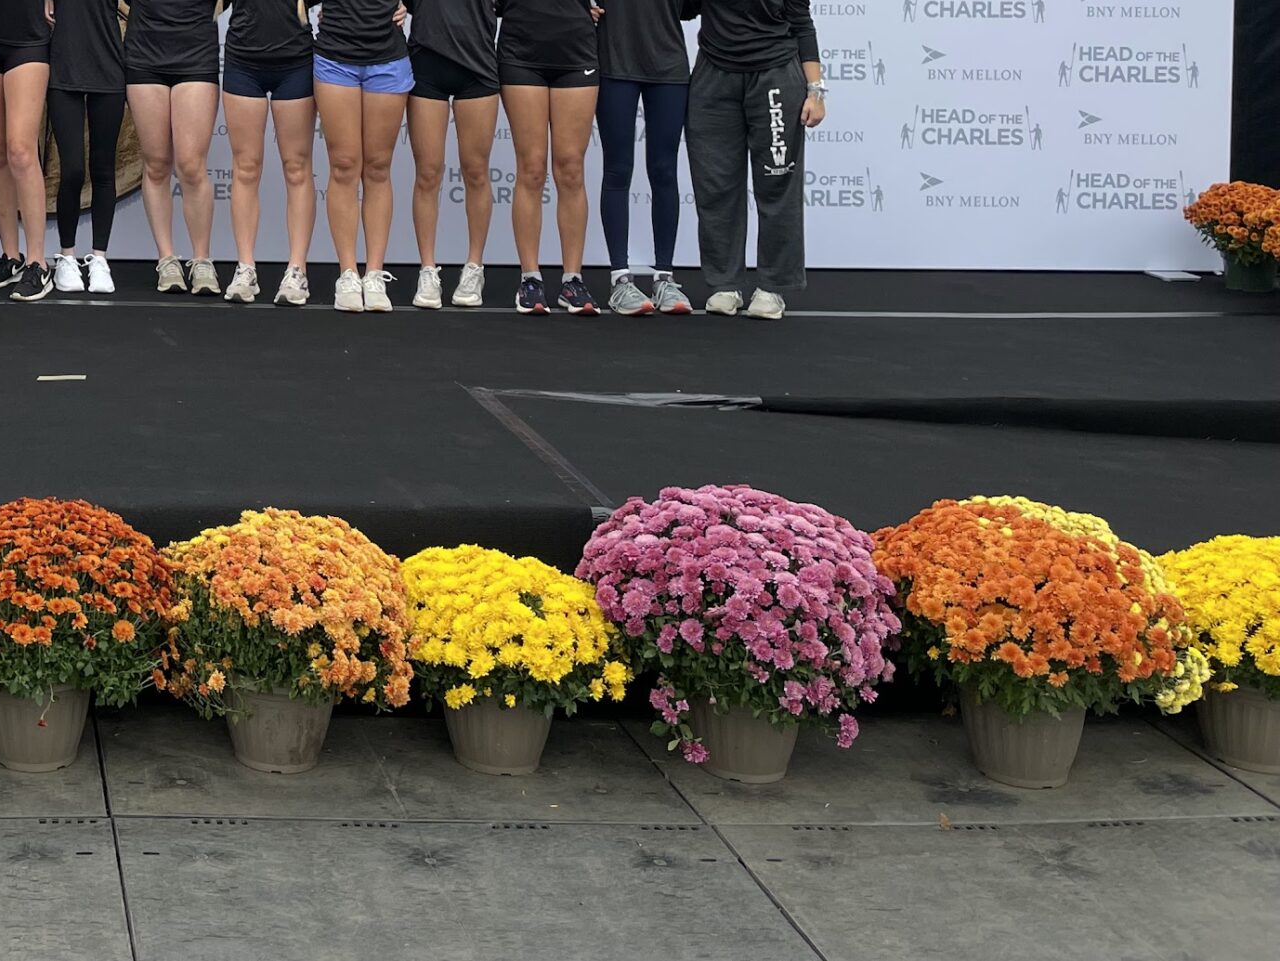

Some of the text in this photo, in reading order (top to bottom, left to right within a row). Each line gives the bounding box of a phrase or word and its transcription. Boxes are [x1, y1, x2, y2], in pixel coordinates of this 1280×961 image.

[923, 0, 1026, 19] CHARLES
[1086, 6, 1180, 18] BNY MELLON
[821, 48, 866, 60] OF THE
[1079, 46, 1181, 62] HEAD OF THE
[928, 69, 1022, 81] BNY MELLON
[1079, 65, 1180, 83] CHARLES
[921, 108, 1023, 125] HEAD OF THE
[768, 88, 788, 167] CREW
[805, 131, 864, 143] MELLON
[921, 127, 1024, 146] CHARLES
[1084, 133, 1177, 145] BNY MELLON
[820, 175, 837, 186] OF
[839, 176, 864, 187] THE
[1076, 173, 1178, 189] HEAD OF THE
[926, 195, 1019, 208] BNY MELLON
[1076, 192, 1178, 210] CHARLES
